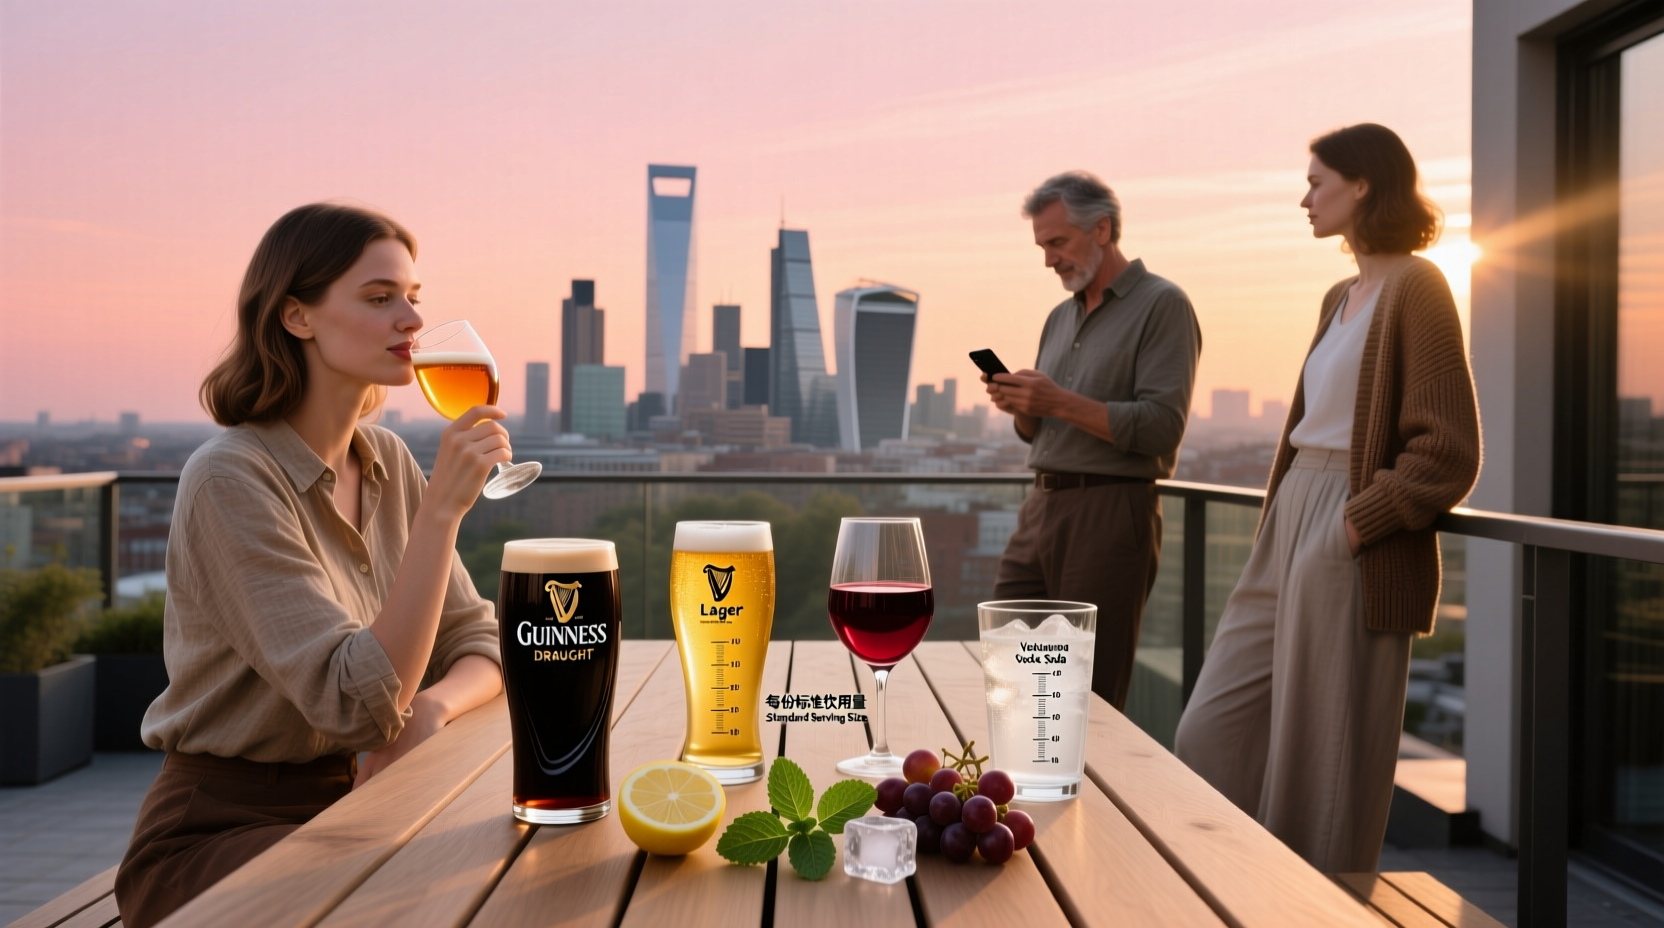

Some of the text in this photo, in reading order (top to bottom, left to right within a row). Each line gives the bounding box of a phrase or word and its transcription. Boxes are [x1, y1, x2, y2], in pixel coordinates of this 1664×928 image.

[700, 603, 744, 621] Lager
[517, 620, 607, 646] GUINNESS
[534, 648, 594, 662] DRAUGHT
